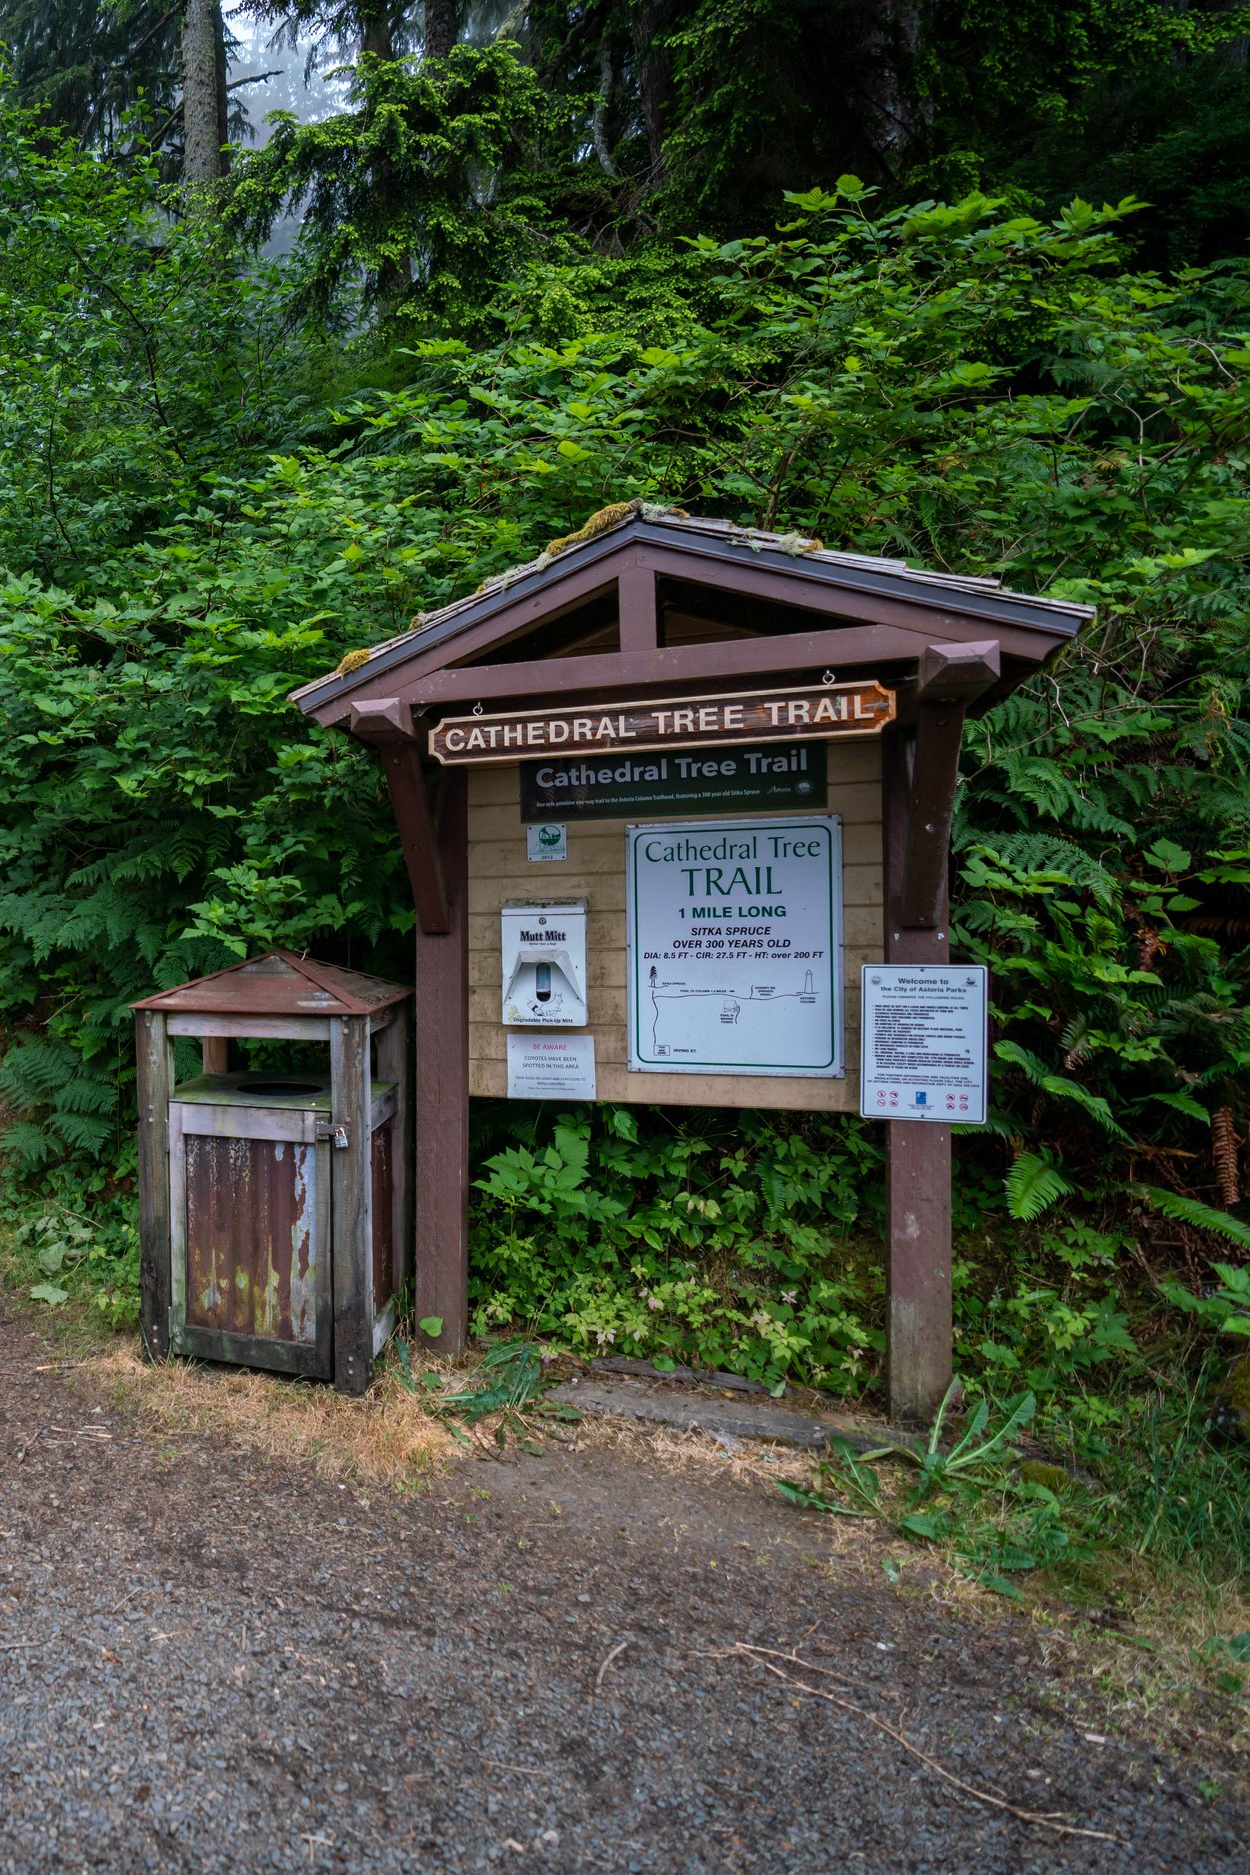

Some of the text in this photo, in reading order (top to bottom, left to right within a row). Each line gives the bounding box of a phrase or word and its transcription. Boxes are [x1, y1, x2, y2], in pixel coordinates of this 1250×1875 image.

[444, 694, 875, 753] CATHEDRAL TREE TRAIL
[536, 748, 807, 788] Cathedral Tree Trail
[645, 836, 821, 862] Cathedral Tree
[681, 866, 782, 896] TRAIL
[678, 906, 787, 918] 1 MILE LONG
[520, 930, 566, 941] Mutt Mitt
[691, 927, 771, 936] SITKA SPRUCE
[672, 939, 791, 948] OVER 300 YEARS OLD
